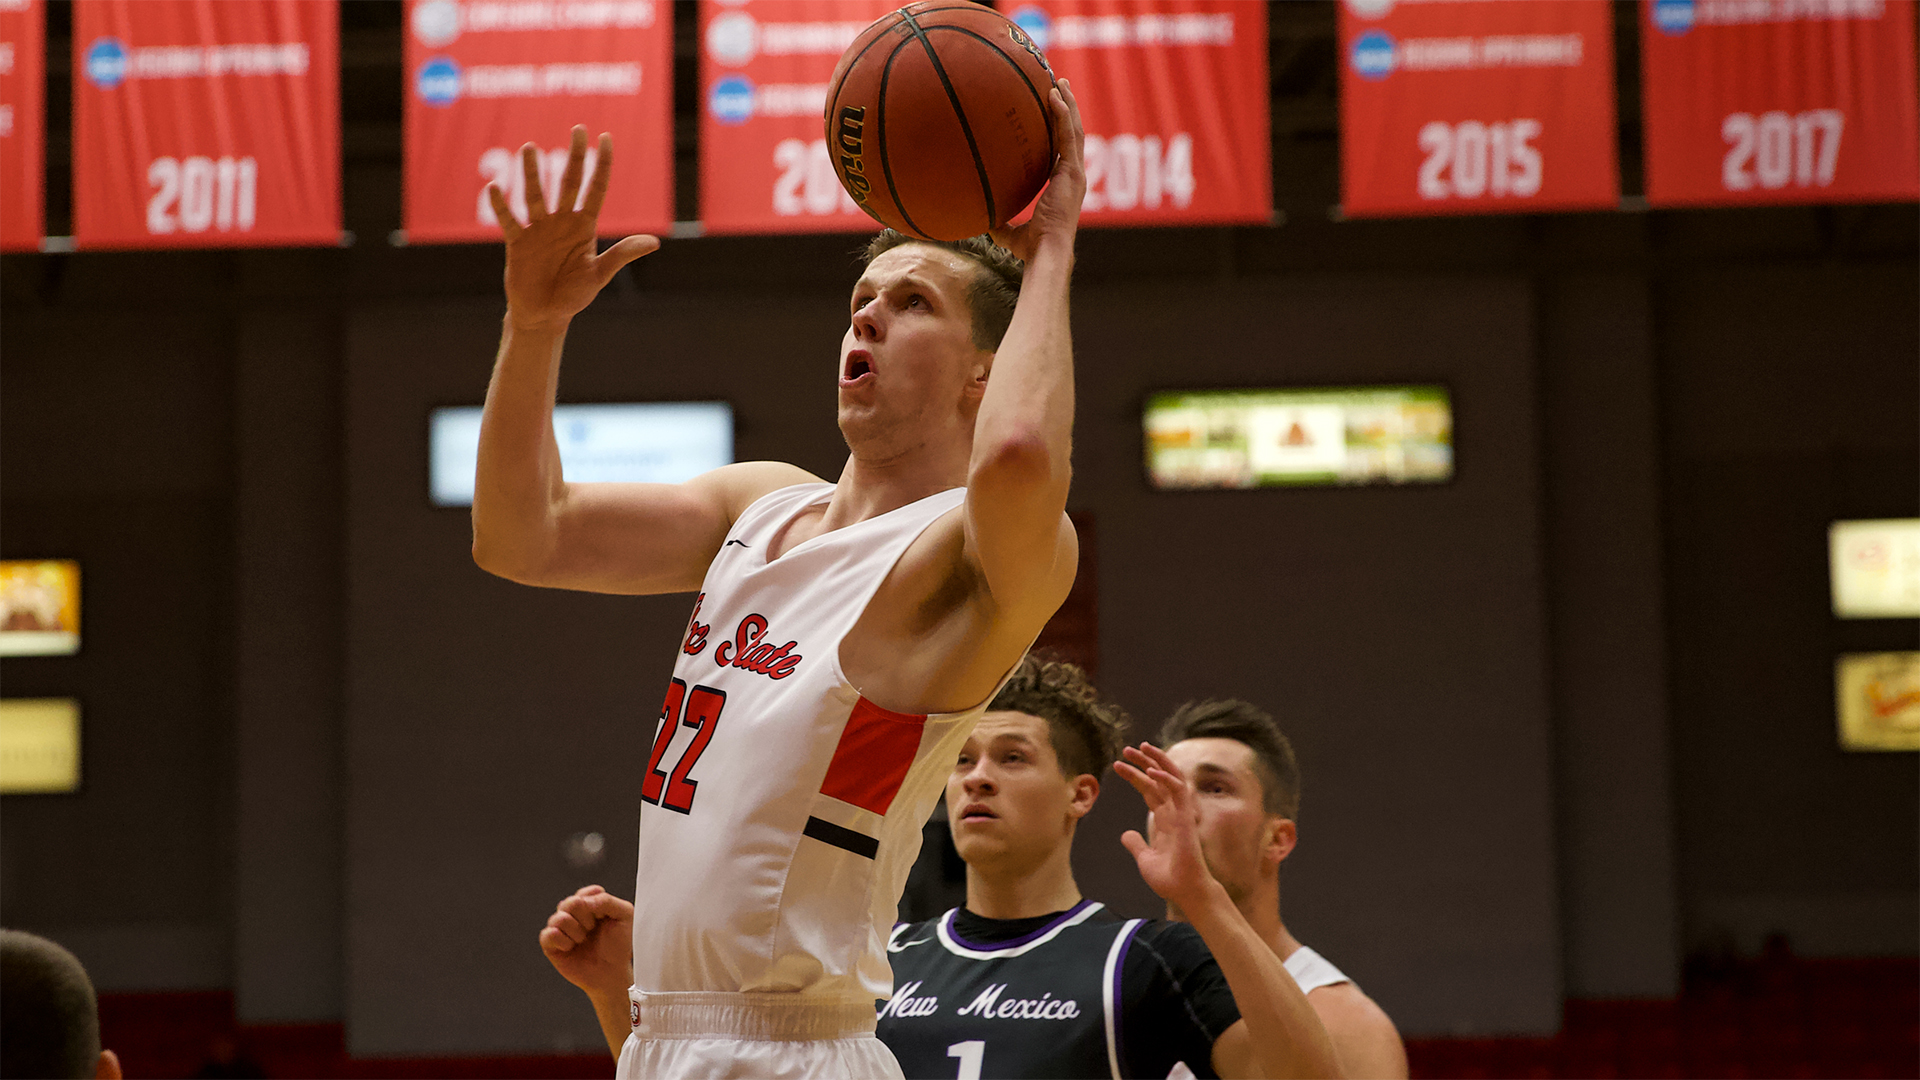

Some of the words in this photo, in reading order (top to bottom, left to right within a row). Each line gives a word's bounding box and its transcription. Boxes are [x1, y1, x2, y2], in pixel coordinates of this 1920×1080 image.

[1084, 132, 1195, 212] 2014
[1417, 118, 1543, 200] 2015
[1722, 108, 1845, 191] 2017
[146, 155, 258, 234] 2011
[715, 613, 802, 680] State
[641, 677, 727, 815] 22
[877, 980, 938, 1021] New
[957, 983, 1081, 1020] Mexico
[946, 1040, 986, 1080] 1
